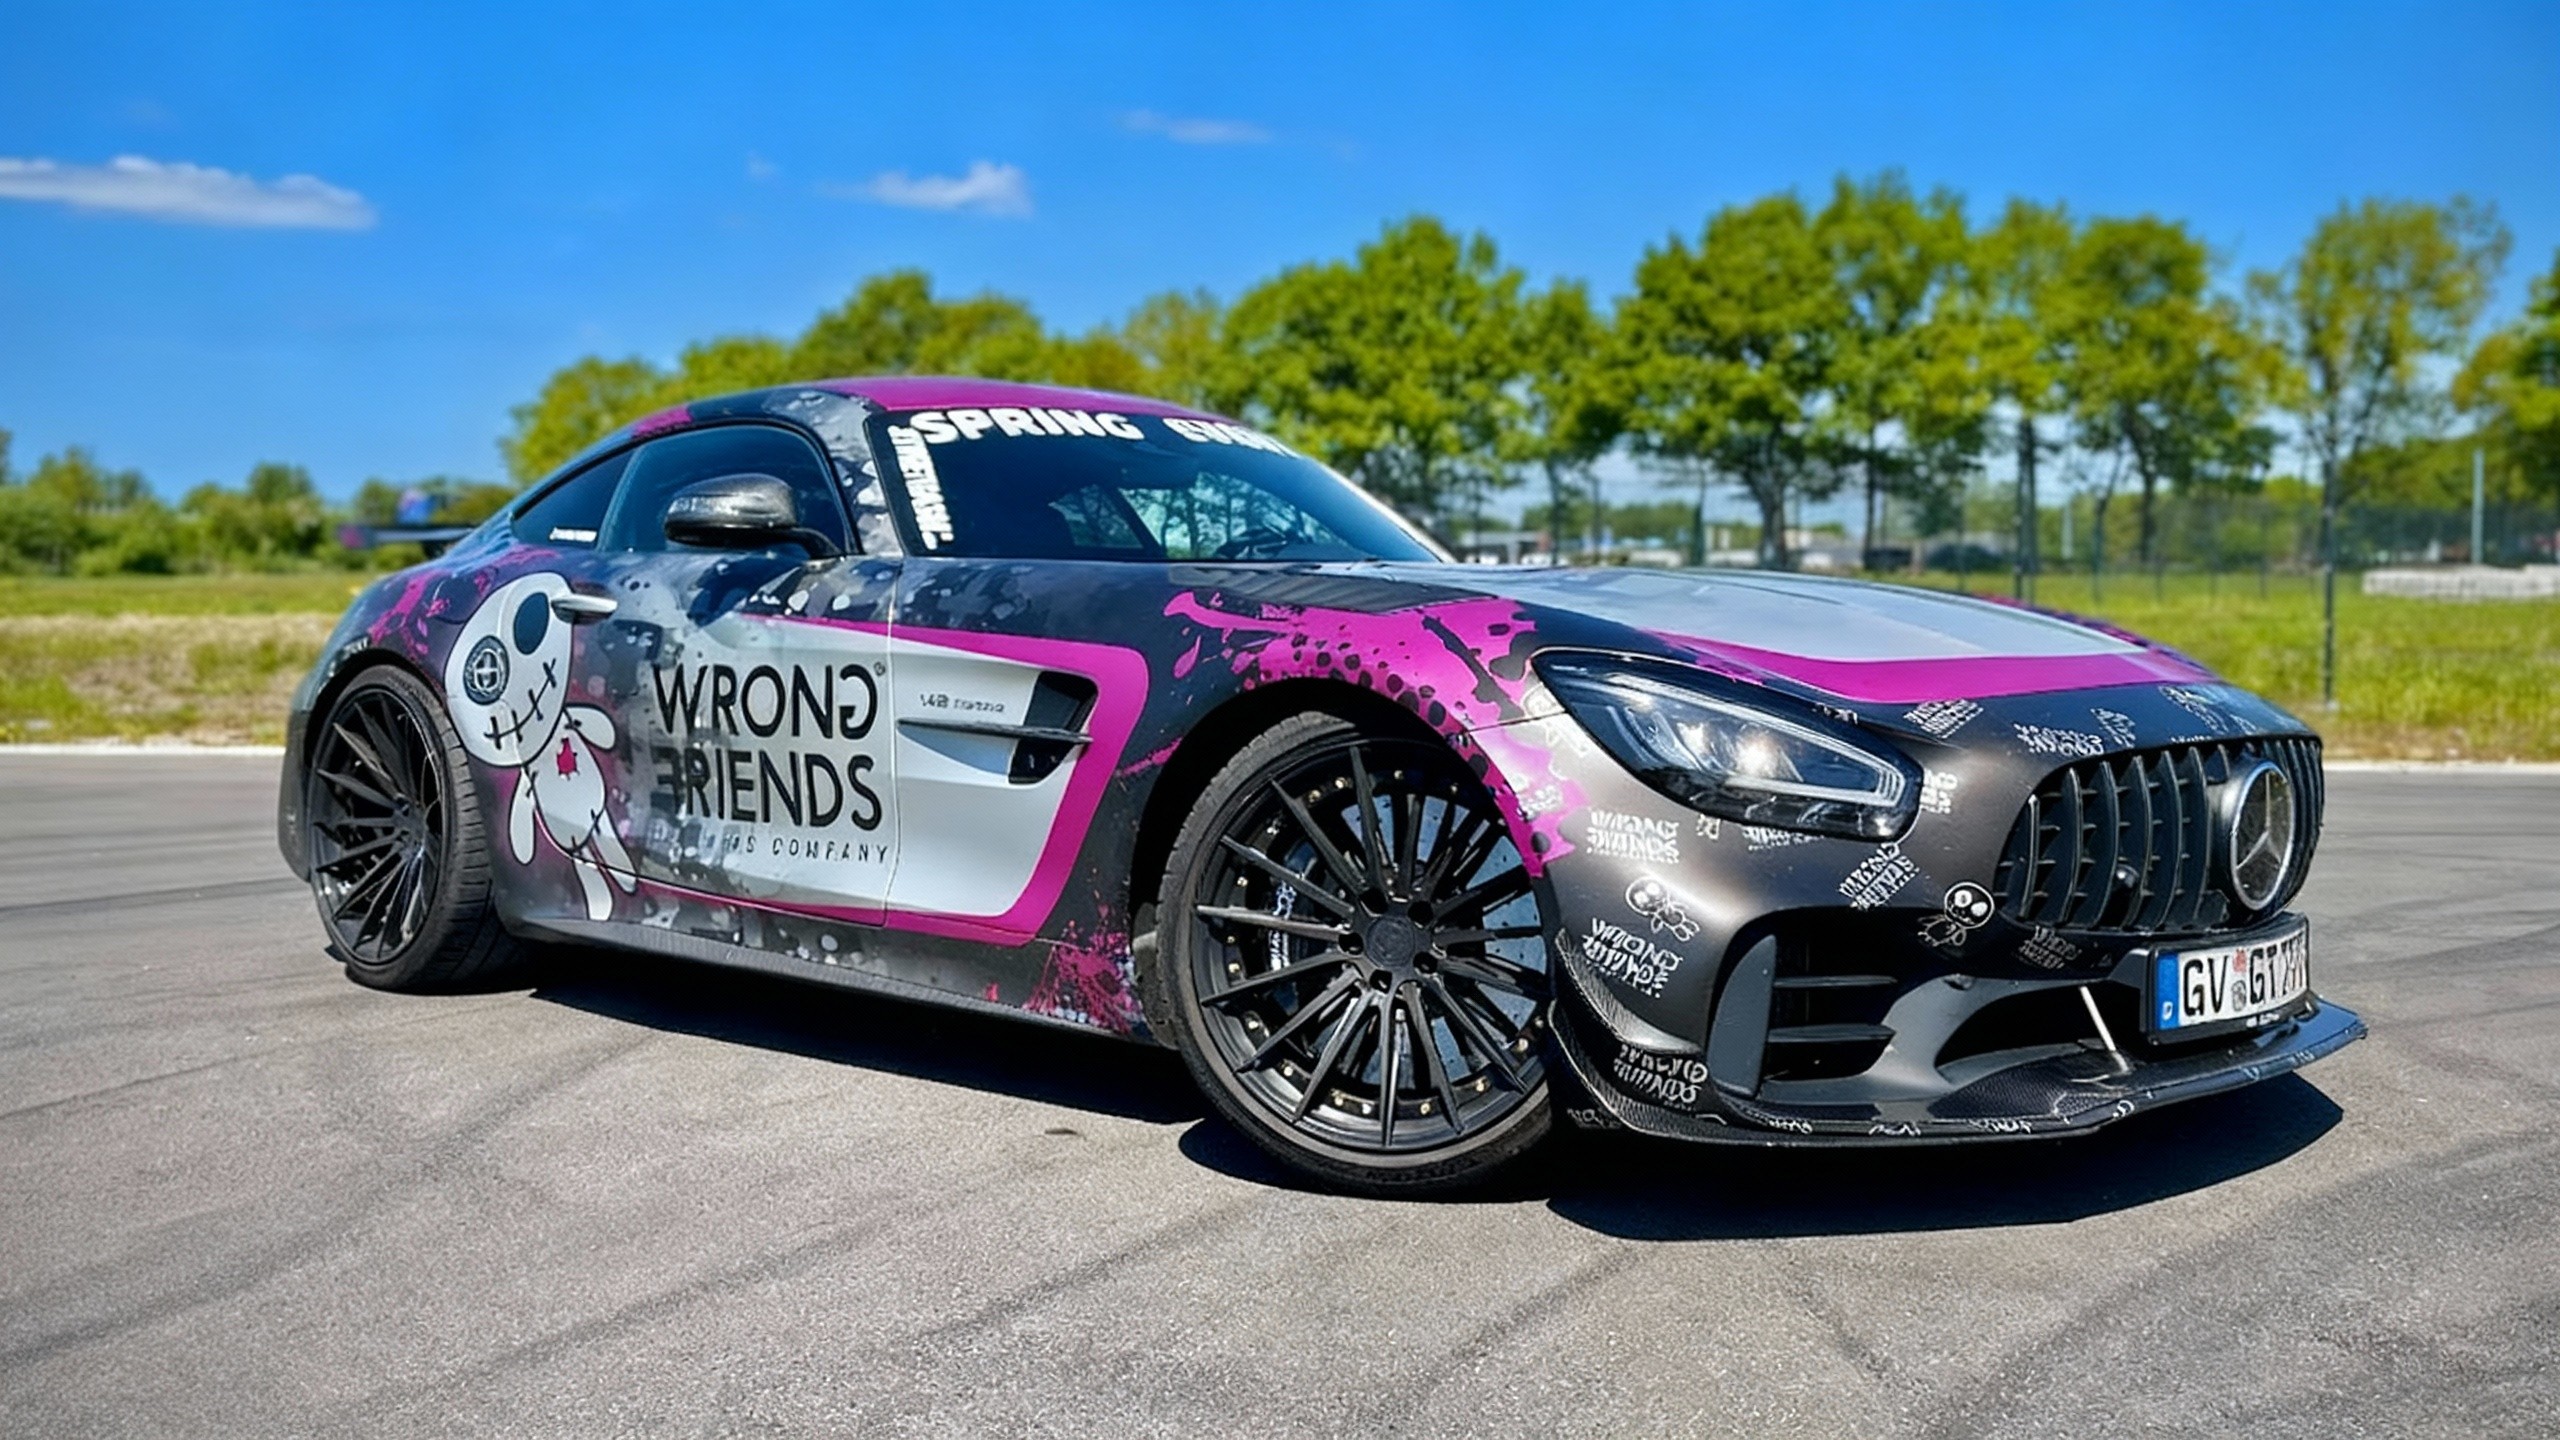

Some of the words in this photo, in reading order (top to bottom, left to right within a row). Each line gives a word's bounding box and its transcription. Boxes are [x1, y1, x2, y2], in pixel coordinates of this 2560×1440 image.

[909, 407, 1145, 443] SPRING
[653, 664, 878, 740] WRONG
[651, 747, 882, 831] FRIENDS
[2183, 956, 2228, 1016] GV
